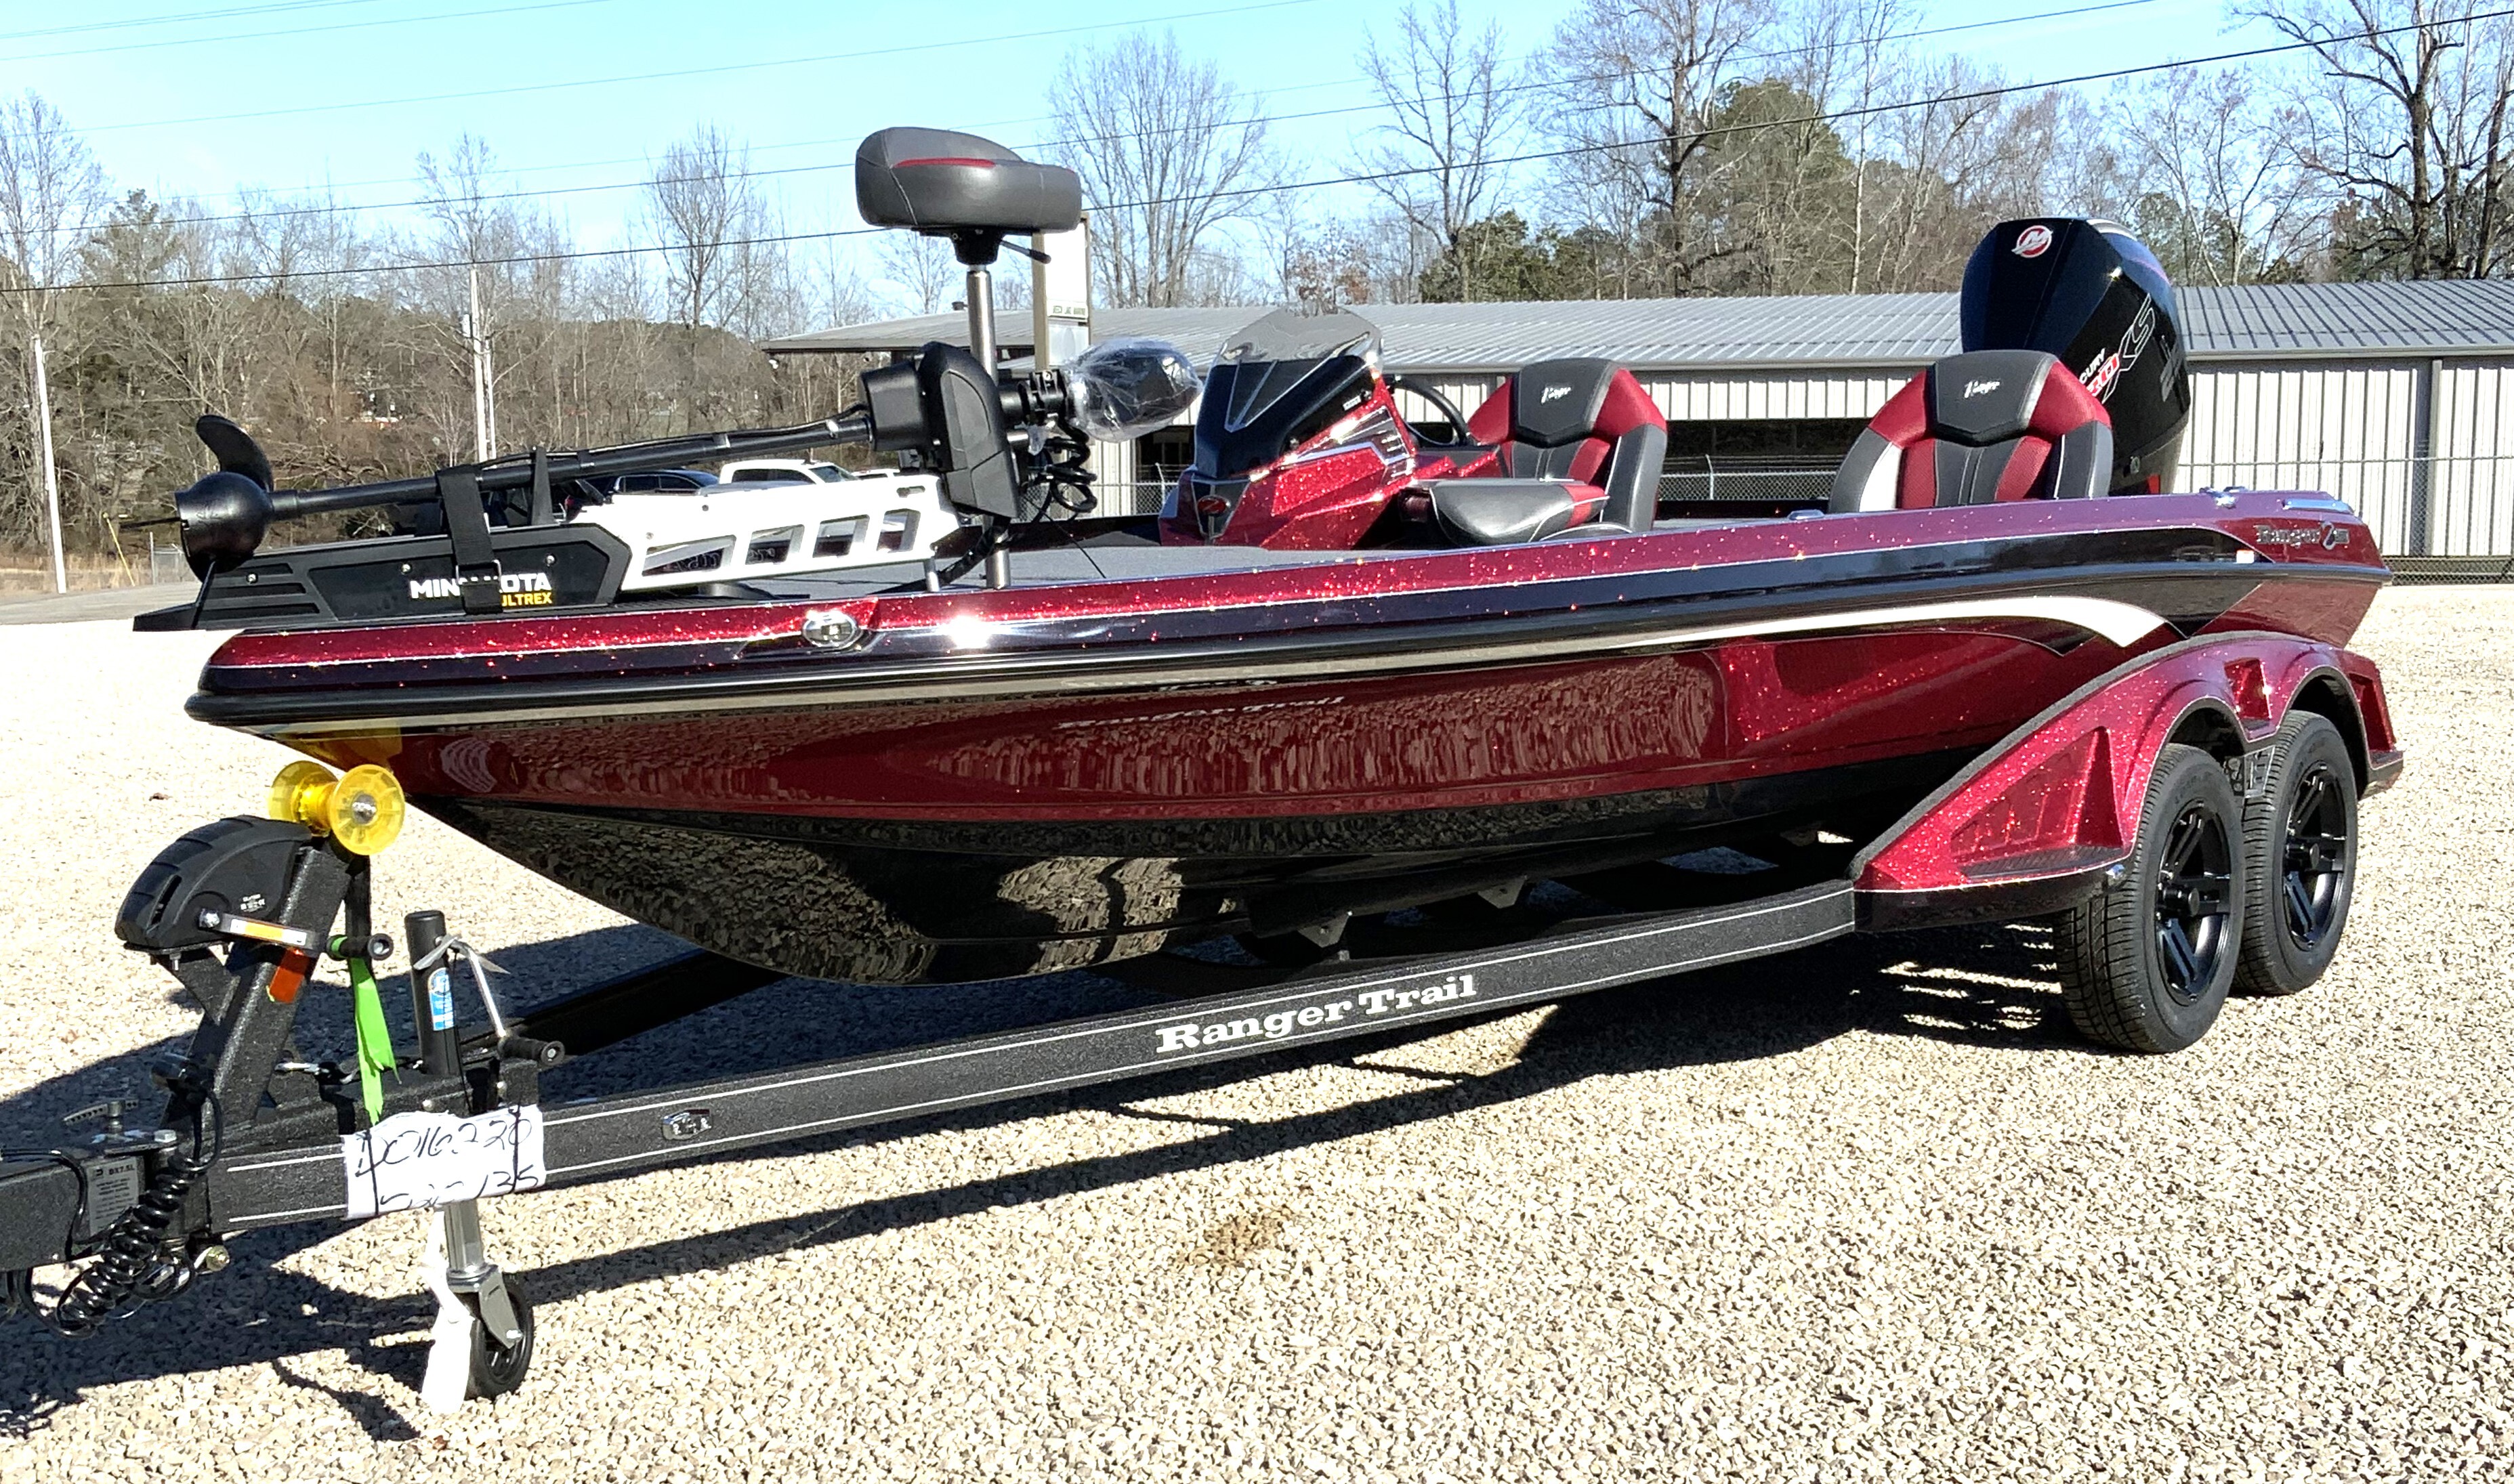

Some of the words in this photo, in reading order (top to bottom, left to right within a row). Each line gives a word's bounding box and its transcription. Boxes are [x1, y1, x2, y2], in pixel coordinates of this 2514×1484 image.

[2079, 347, 2106, 385] CURY
[2102, 293, 2156, 404] XS
[1156, 998, 1352, 1053] Ranger
[1358, 974, 1477, 1015] Trail
